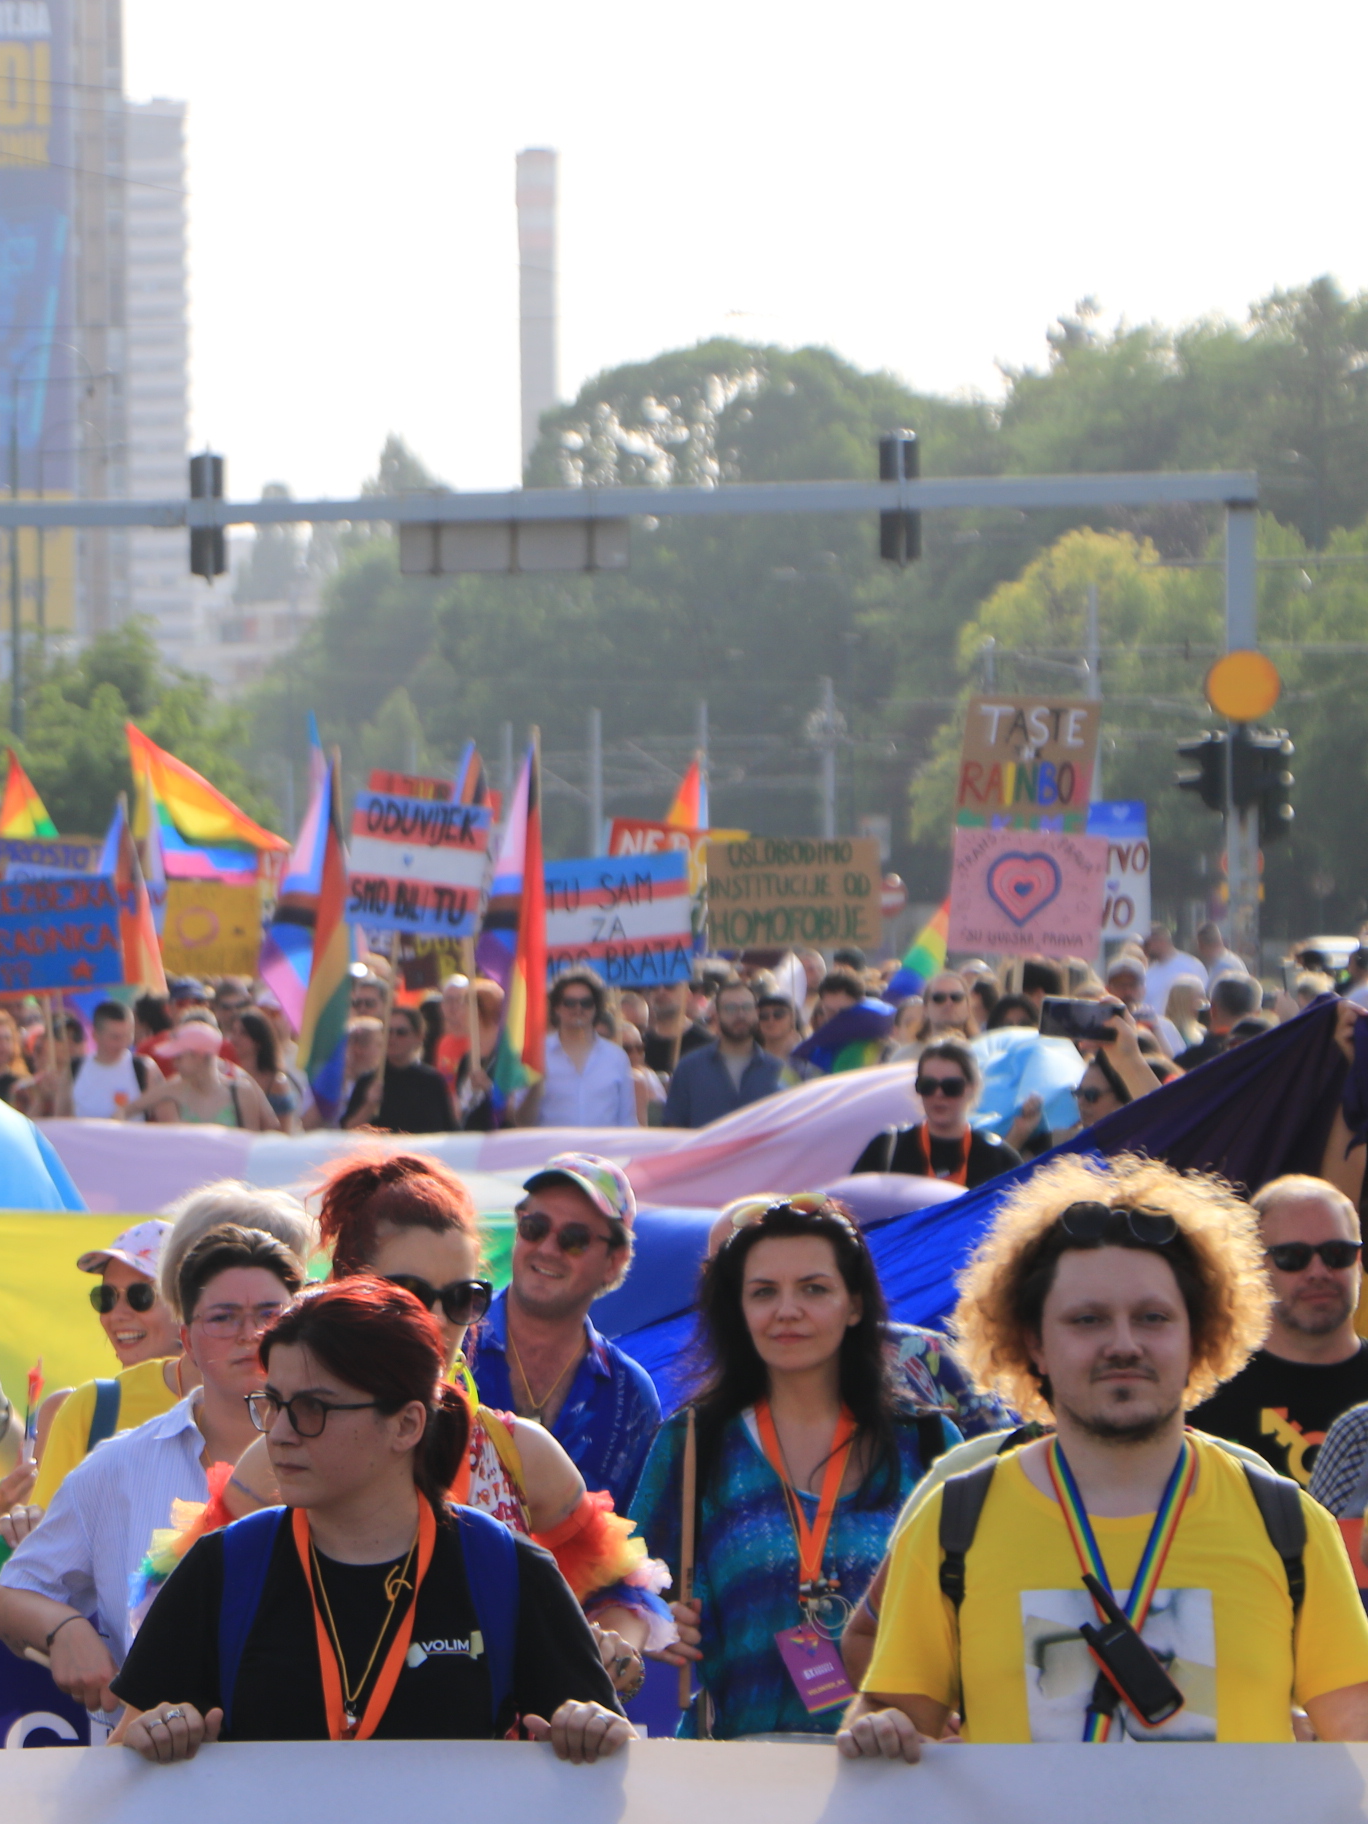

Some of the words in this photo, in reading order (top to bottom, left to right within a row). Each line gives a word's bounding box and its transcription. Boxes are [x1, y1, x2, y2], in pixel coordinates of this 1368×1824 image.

[980, 705, 1088, 747] TASTE
[366, 796, 481, 848] ODUVIJEK
[727, 839, 854, 868] OSLOBODIMO
[544, 878, 580, 914] TU
[598, 870, 654, 911] SAM
[708, 872, 834, 900] INSTITUCIJE
[842, 871, 872, 898] OD
[434, 886, 469, 927] TU
[709, 903, 871, 945] HOMOFOBIJE
[590, 915, 628, 944] ZA
[604, 940, 694, 981] BRATA
[421, 1638, 470, 1652] VOLIM
